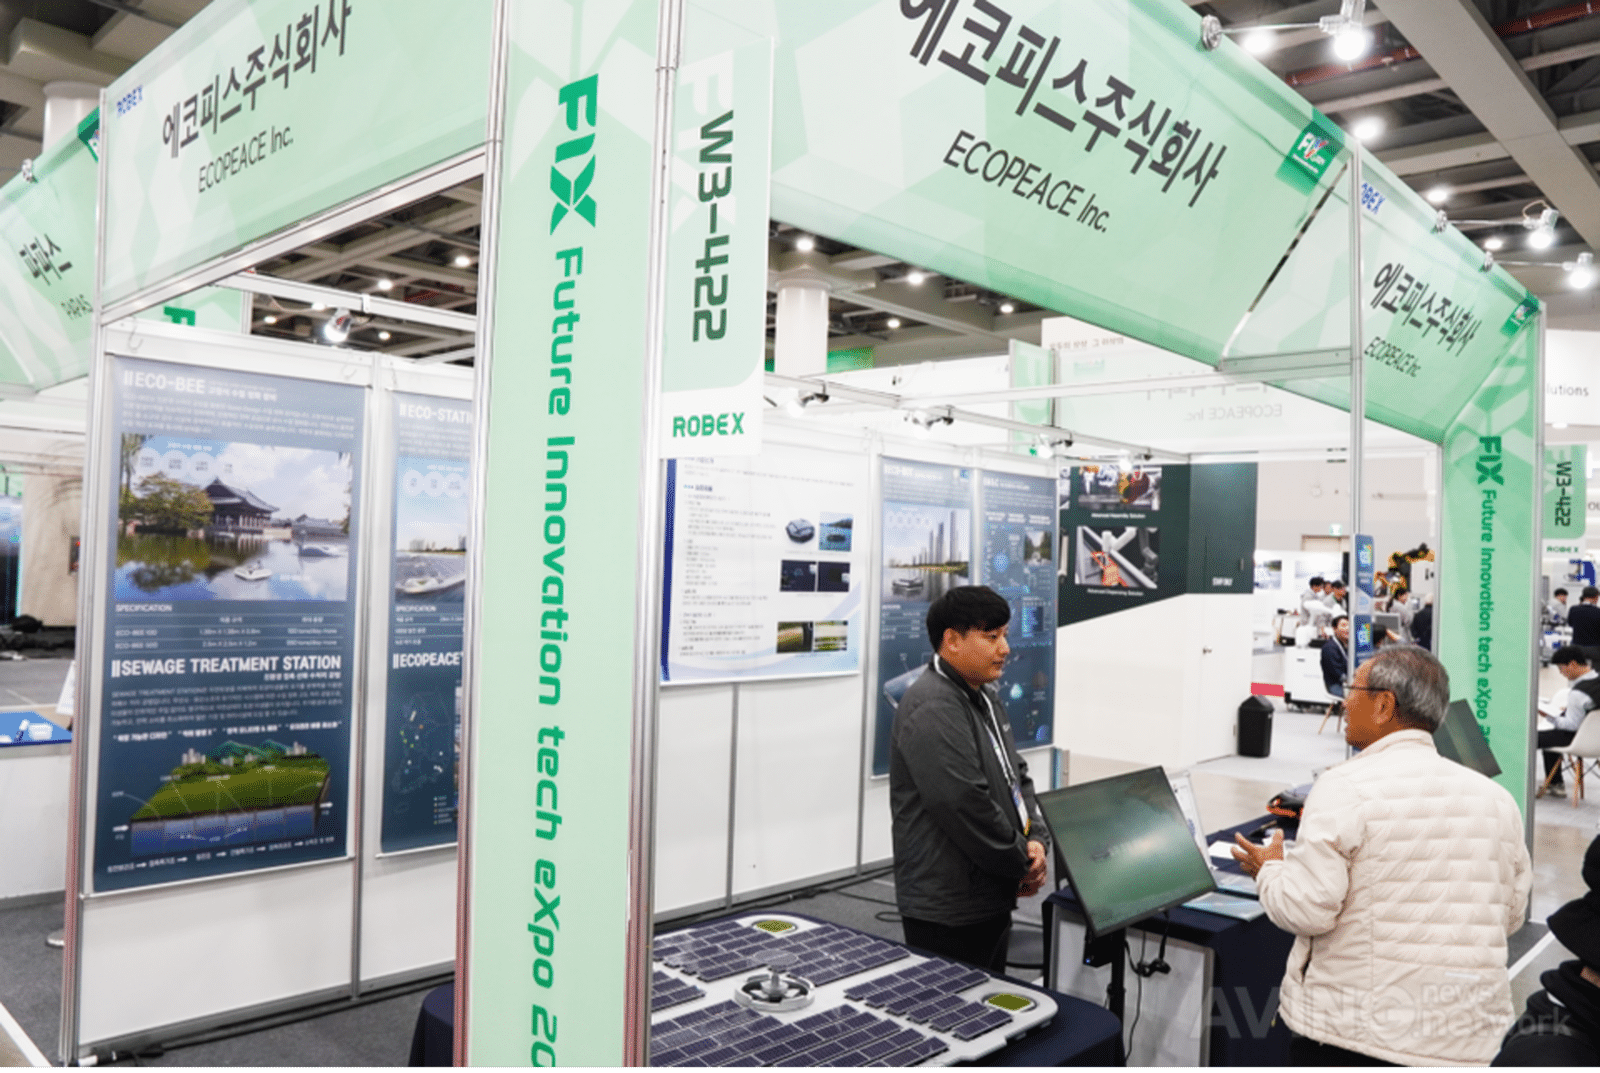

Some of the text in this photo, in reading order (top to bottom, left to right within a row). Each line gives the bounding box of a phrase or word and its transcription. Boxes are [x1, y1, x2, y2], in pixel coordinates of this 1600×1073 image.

[162, 0, 352, 158] 에코피스주식회사
[900, 0, 1227, 208] 에코피스주식회사
[198, 124, 294, 194] ECOPEACE Inc.
[943, 130, 1110, 233] ECOPEACE Inc.
[693, 109, 734, 343] W3-422
[1370, 263, 1483, 358] 에코피스주식회사
[135, 372, 206, 395] ECO-BEE
[673, 412, 745, 438] ROBEX
[1475, 436, 1504, 486] FIX
[1554, 460, 1573, 527] W3-422
[1481, 489, 1498, 543] Future
[527, 73, 599, 1067] FIX Future Innovation tech eXpo 20
[1479, 547, 1496, 632] Innovation
[121, 654, 341, 677] SEWAGE TREATMENT STATION
[1477, 636, 1494, 673] tech
